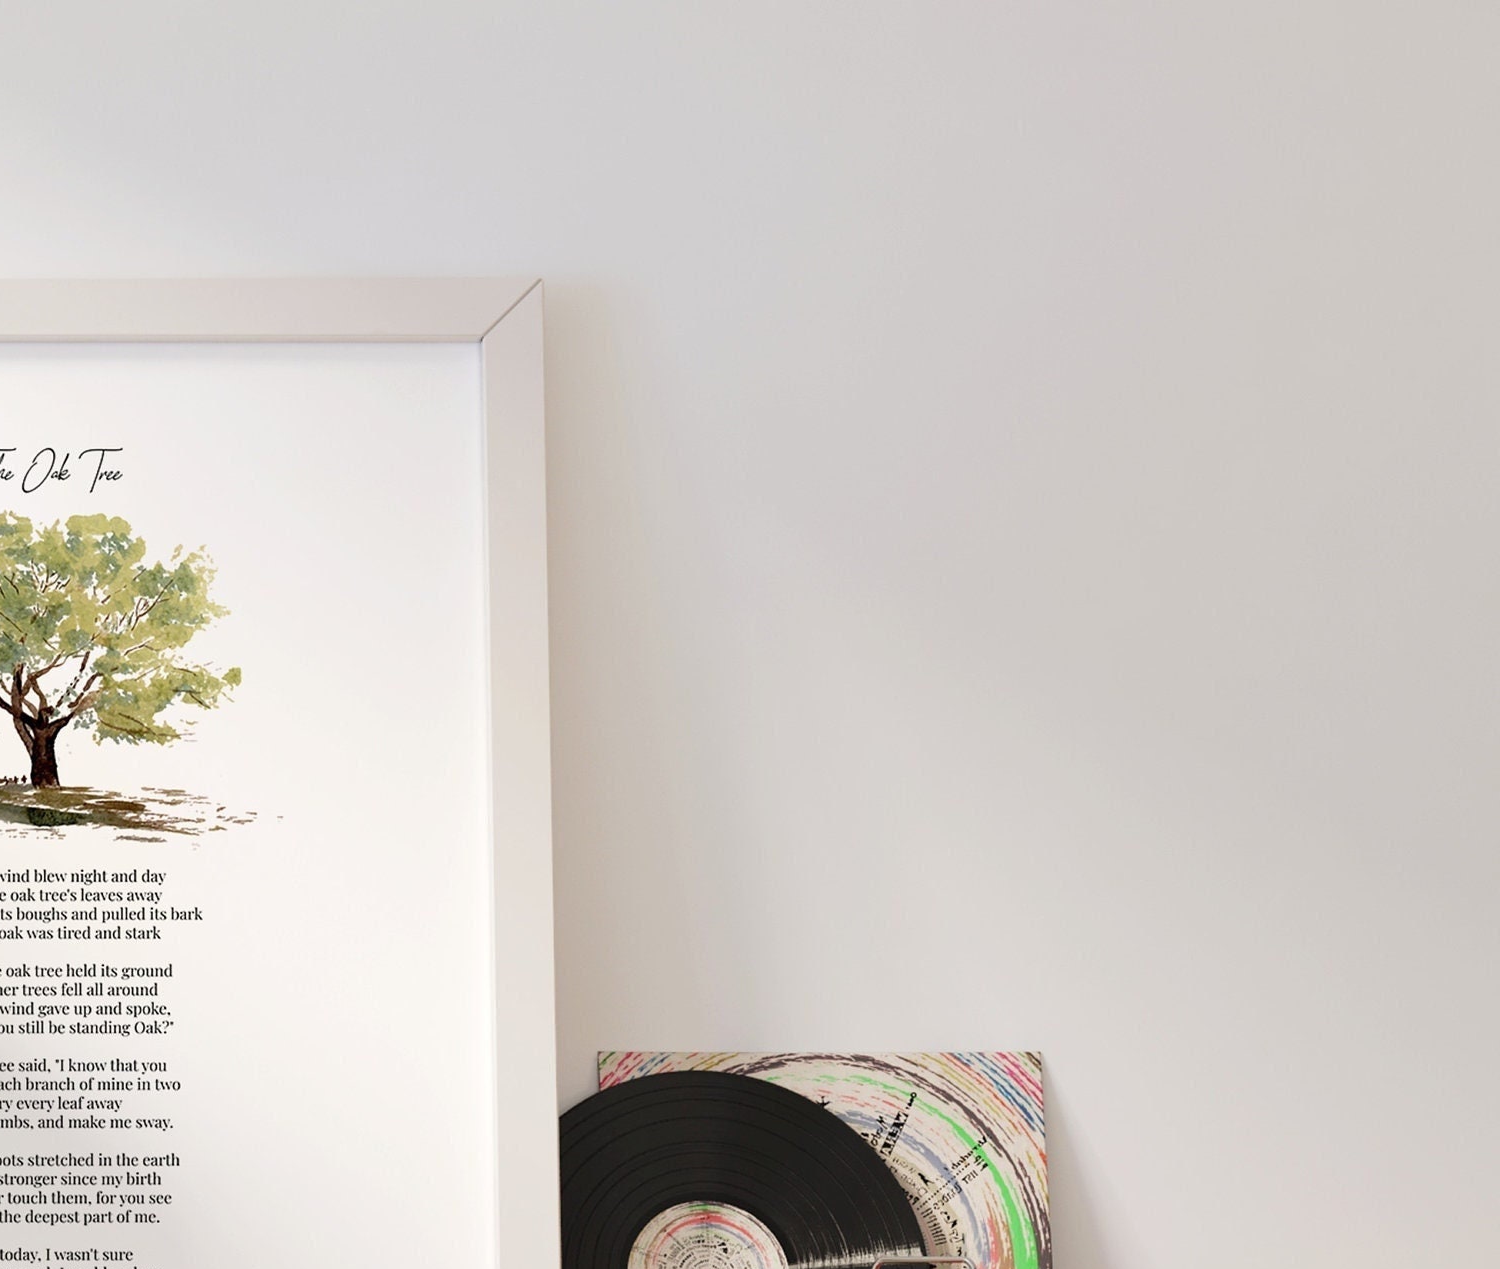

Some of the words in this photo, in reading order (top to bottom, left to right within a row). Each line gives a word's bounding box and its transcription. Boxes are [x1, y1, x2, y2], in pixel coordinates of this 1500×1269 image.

[21, 447, 71, 493] Oak
[78, 447, 124, 493] Tree
[34, 868, 68, 883] blew
[70, 868, 108, 886] night
[110, 868, 137, 883] and
[141, 868, 167, 886] day
[10, 887, 36, 902] oak
[39, 888, 78, 902] tree's
[80, 887, 124, 902] leaves
[126, 891, 163, 905] away
[16, 906, 68, 924] boughs
[71, 906, 98, 921] and
[102, 906, 146, 924] pulled
[150, 906, 167, 921] its
[170, 906, 203, 921] bark
[26, 929, 54, 940] was
[57, 925, 91, 940] tired
[94, 925, 121, 940] and
[125, 925, 161, 940] stark
[5, 963, 31, 978] oak
[34, 965, 63, 978] tree
[66, 963, 97, 978] held
[101, 963, 118, 978] its
[120, 963, 173, 980] ground
[22, 984, 58, 997] trees
[61, 982, 83, 997] fell
[86, 982, 104, 997] all
[107, 982, 158, 997] around
[0, 1001, 35, 1016] wind
[37, 1004, 70, 1018] gave
[74, 1005, 92, 1018] up
[95, 1001, 122, 1016] and
[125, 1001, 171, 1018] spoke,
[18, 1020, 45, 1035] still
[48, 1020, 66, 1035] be
[69, 1020, 131, 1037] standing
[134, 1020, 174, 1035] Oak?"
[18, 1057, 51, 1073] said,
[55, 1059, 64, 1072] "I
[68, 1058, 107, 1072] know
[110, 1058, 138, 1072] that
[141, 1062, 167, 1075] you
[25, 1076, 75, 1092] branch
[79, 1077, 95, 1091] of
[97, 1077, 134, 1092] mine
[137, 1077, 151, 1091] in
[155, 1078, 181, 1091] two
[16, 1099, 55, 1113] every
[57, 1095, 85, 1111] leaf
[86, 1099, 123, 1113] away
[37, 1114, 64, 1129] and
[68, 1114, 106, 1129] make
[110, 1118, 132, 1129] me
[135, 1118, 174, 1132] sway.
[27, 1152, 94, 1167] stretched
[98, 1152, 112, 1167] in
[116, 1152, 139, 1167] the
[142, 1152, 180, 1167] earth
[60, 1171, 98, 1186] since
[101, 1175, 124, 1189] my
[126, 1171, 162, 1186] birth
[7, 1190, 48, 1205] touch
[51, 1190, 92, 1206] them,
[96, 1190, 117, 1205] for
[119, 1194, 145, 1208] you
[148, 1194, 172, 1205] see
[24, 1209, 80, 1227] deepest
[83, 1211, 114, 1227] part
[116, 1209, 133, 1224] of
[134, 1212, 161, 1224] me.
[0, 1247, 42, 1264] today,
[46, 1248, 51, 1262] I
[53, 1248, 99, 1262] wasn't
[102, 1251, 134, 1262] sure
